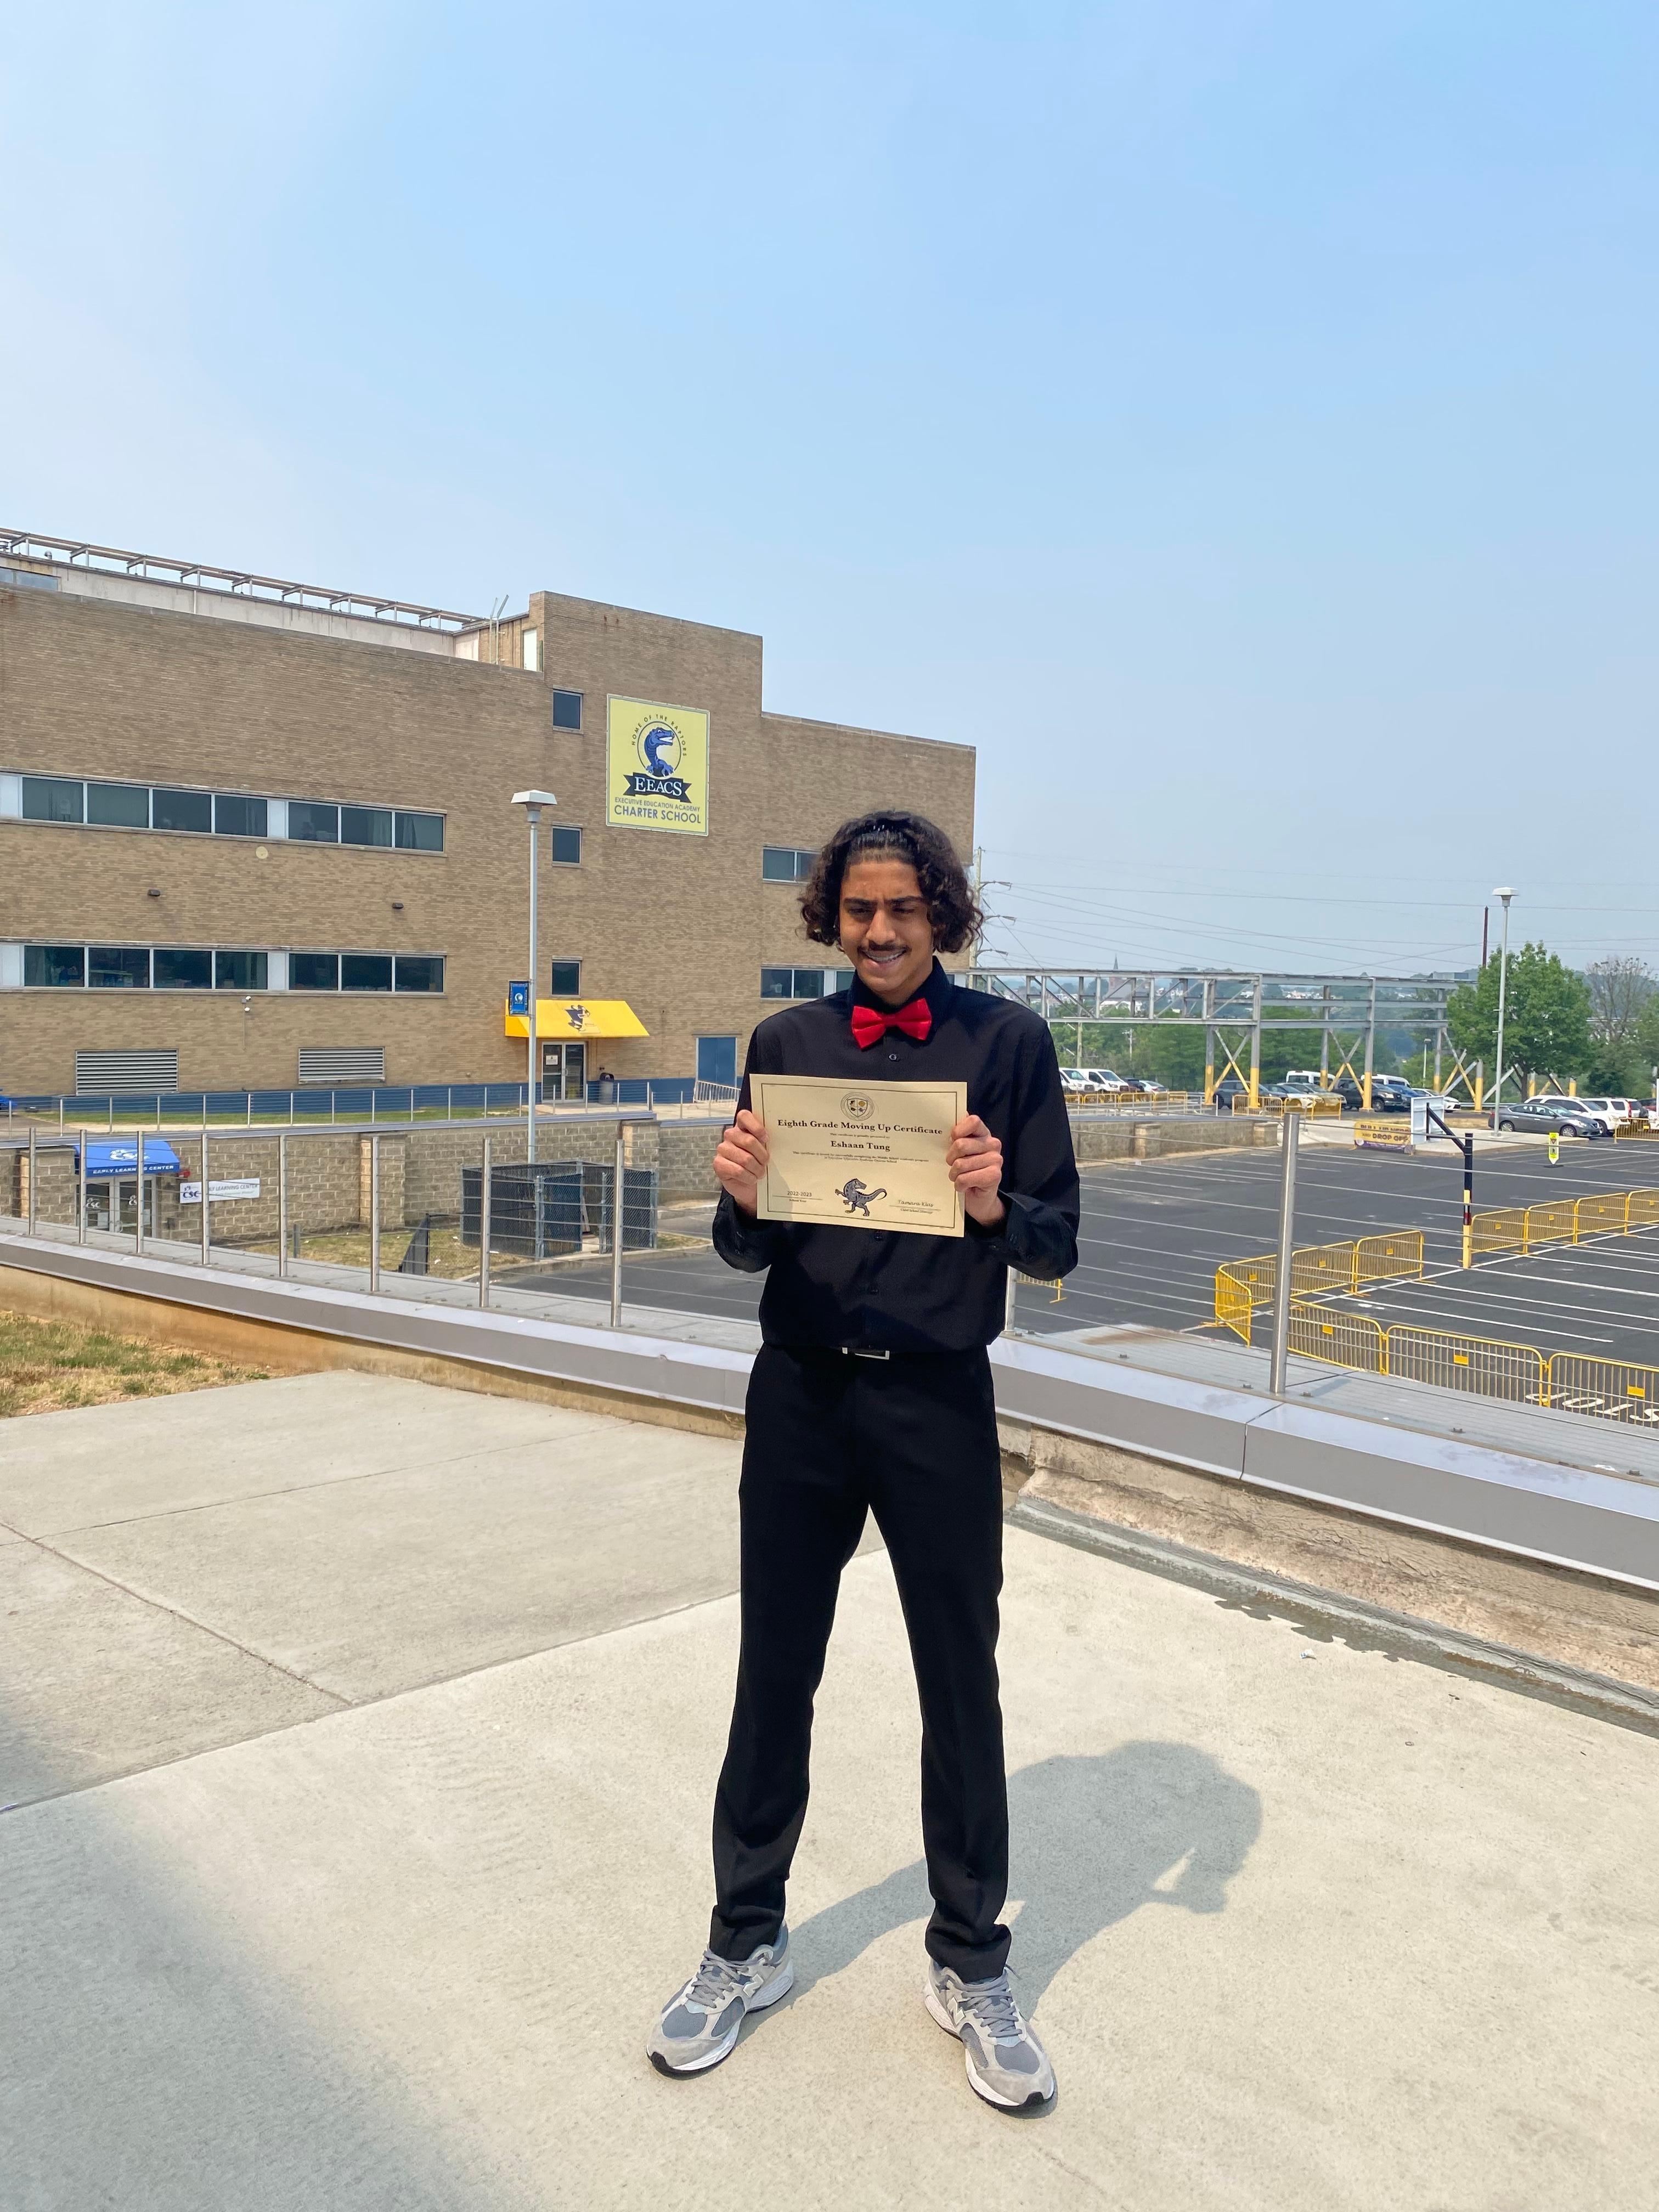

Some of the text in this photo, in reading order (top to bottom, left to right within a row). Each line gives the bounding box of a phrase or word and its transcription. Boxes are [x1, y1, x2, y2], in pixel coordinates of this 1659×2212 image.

[632, 723, 642, 746] HOME
[671, 721, 686, 756] RAPTORS
[634, 776, 682, 796] EEACS
[615, 797, 700, 812] EXECUTIVE EDUCATION ACADEMY
[614, 805, 701, 823] CHARTER SCHOOL
[777, 1120, 808, 1128] Eighth
[841, 1122, 875, 1132] Moving
[878, 1124, 891, 1132] Up
[894, 1125, 943, 1135] Certificate
[831, 1141, 890, 1152] Eshaan Tung
